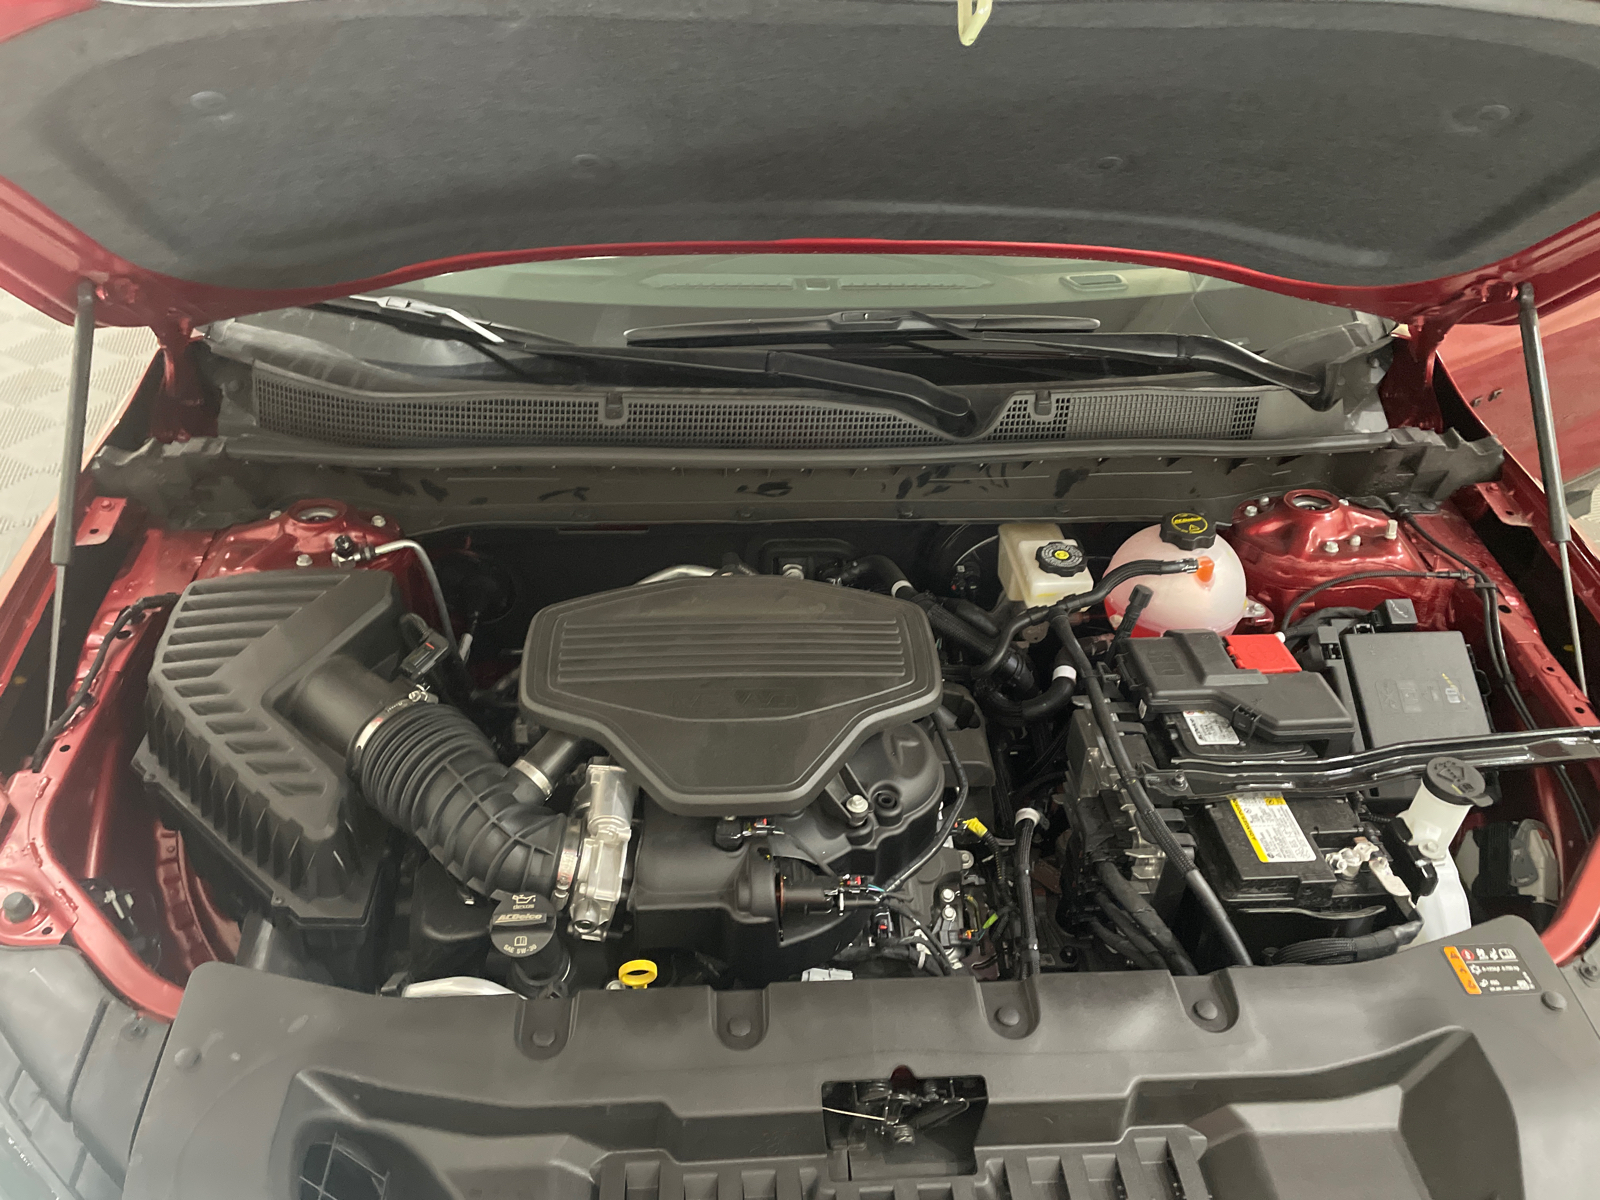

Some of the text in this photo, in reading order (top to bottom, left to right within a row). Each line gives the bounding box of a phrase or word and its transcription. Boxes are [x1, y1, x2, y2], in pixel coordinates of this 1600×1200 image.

[496, 913, 543, 922] ACDelco
[503, 944, 537, 954] SAE 5W-30
